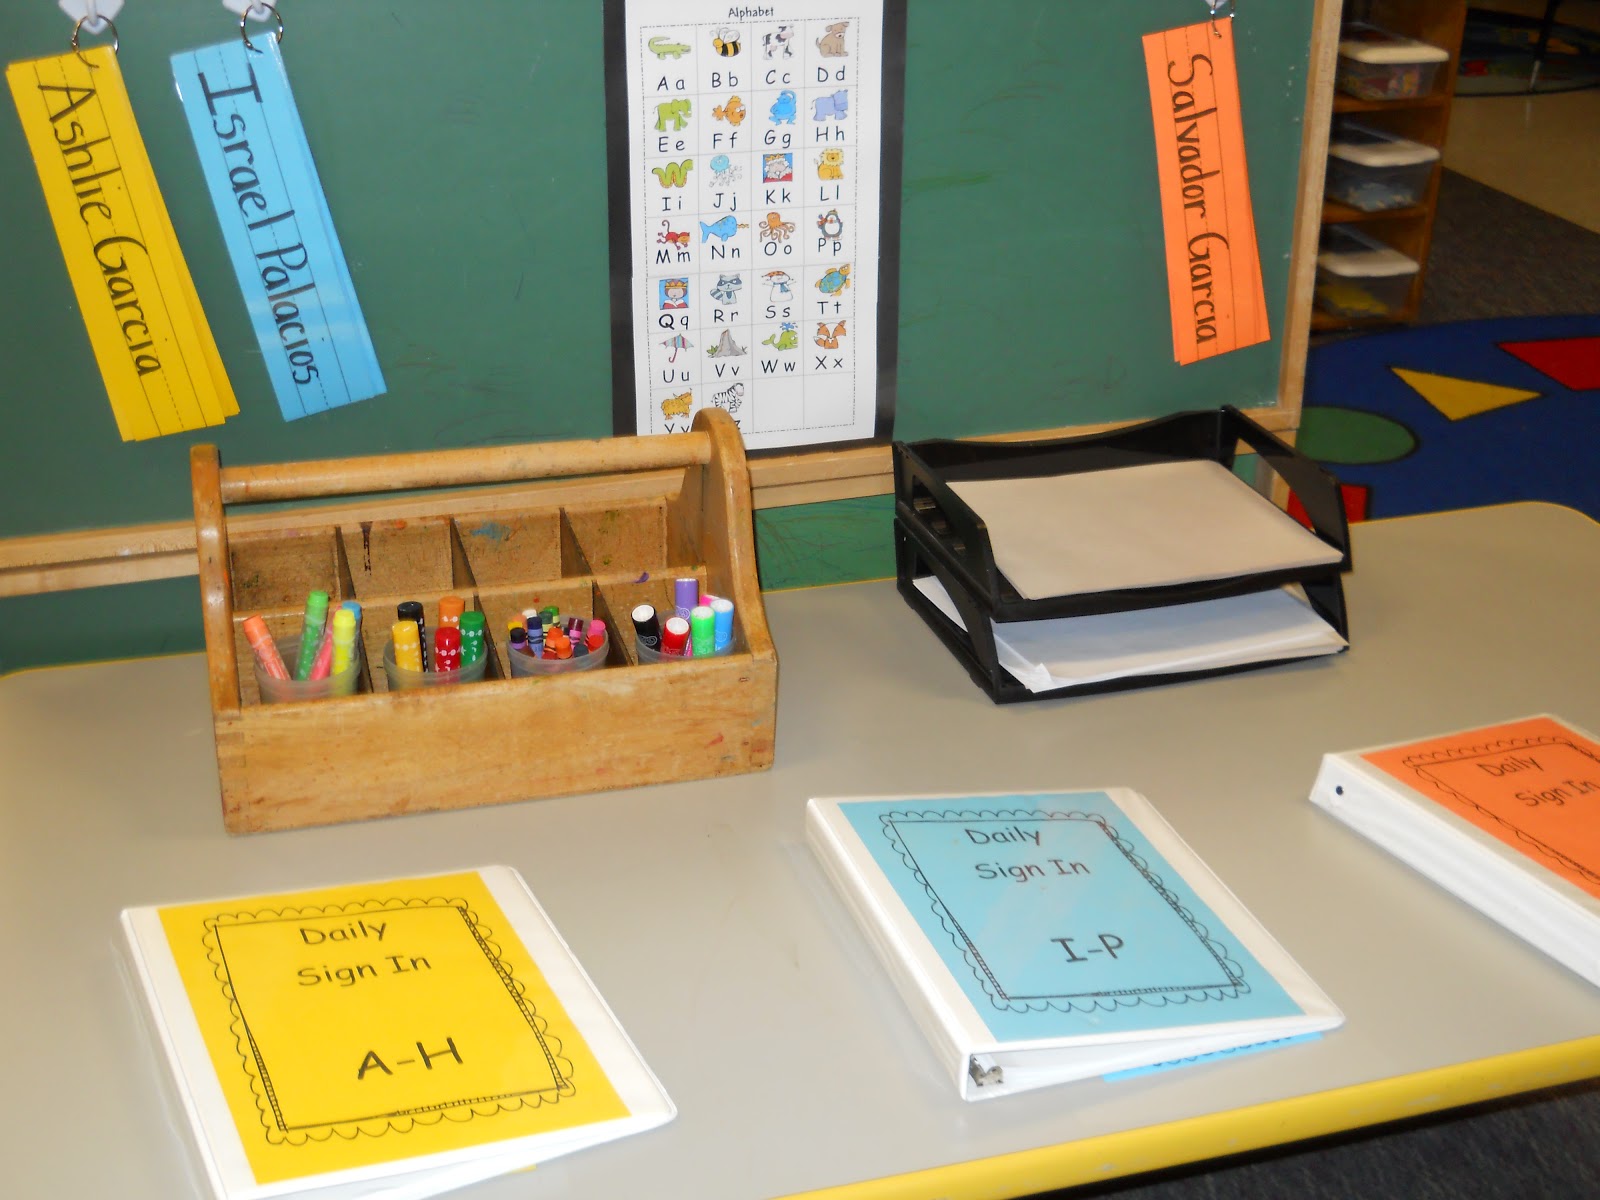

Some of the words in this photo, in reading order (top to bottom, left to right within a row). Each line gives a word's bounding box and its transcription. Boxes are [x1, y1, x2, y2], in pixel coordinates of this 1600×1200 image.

[728, 7, 774, 23] Alphabet
[1167, 54, 1220, 218] Salvador
[37, 84, 122, 226] Ashlie
[93, 236, 162, 377] Garcia
[198, 64, 295, 230] Israel
[255, 242, 320, 386] Palacios
[1188, 232, 1229, 344] Garcia
[1476, 756, 1544, 777] Daily
[1515, 787, 1572, 807] Sign
[1562, 780, 1600, 796] In
[965, 827, 1042, 848] Daily
[974, 861, 1045, 883] Sign
[1048, 858, 1092, 876] In
[300, 920, 388, 946] Daily
[1050, 933, 1126, 964] I-P
[297, 959, 378, 988] Sign
[384, 955, 433, 976] In
[357, 1037, 463, 1080] A-H
